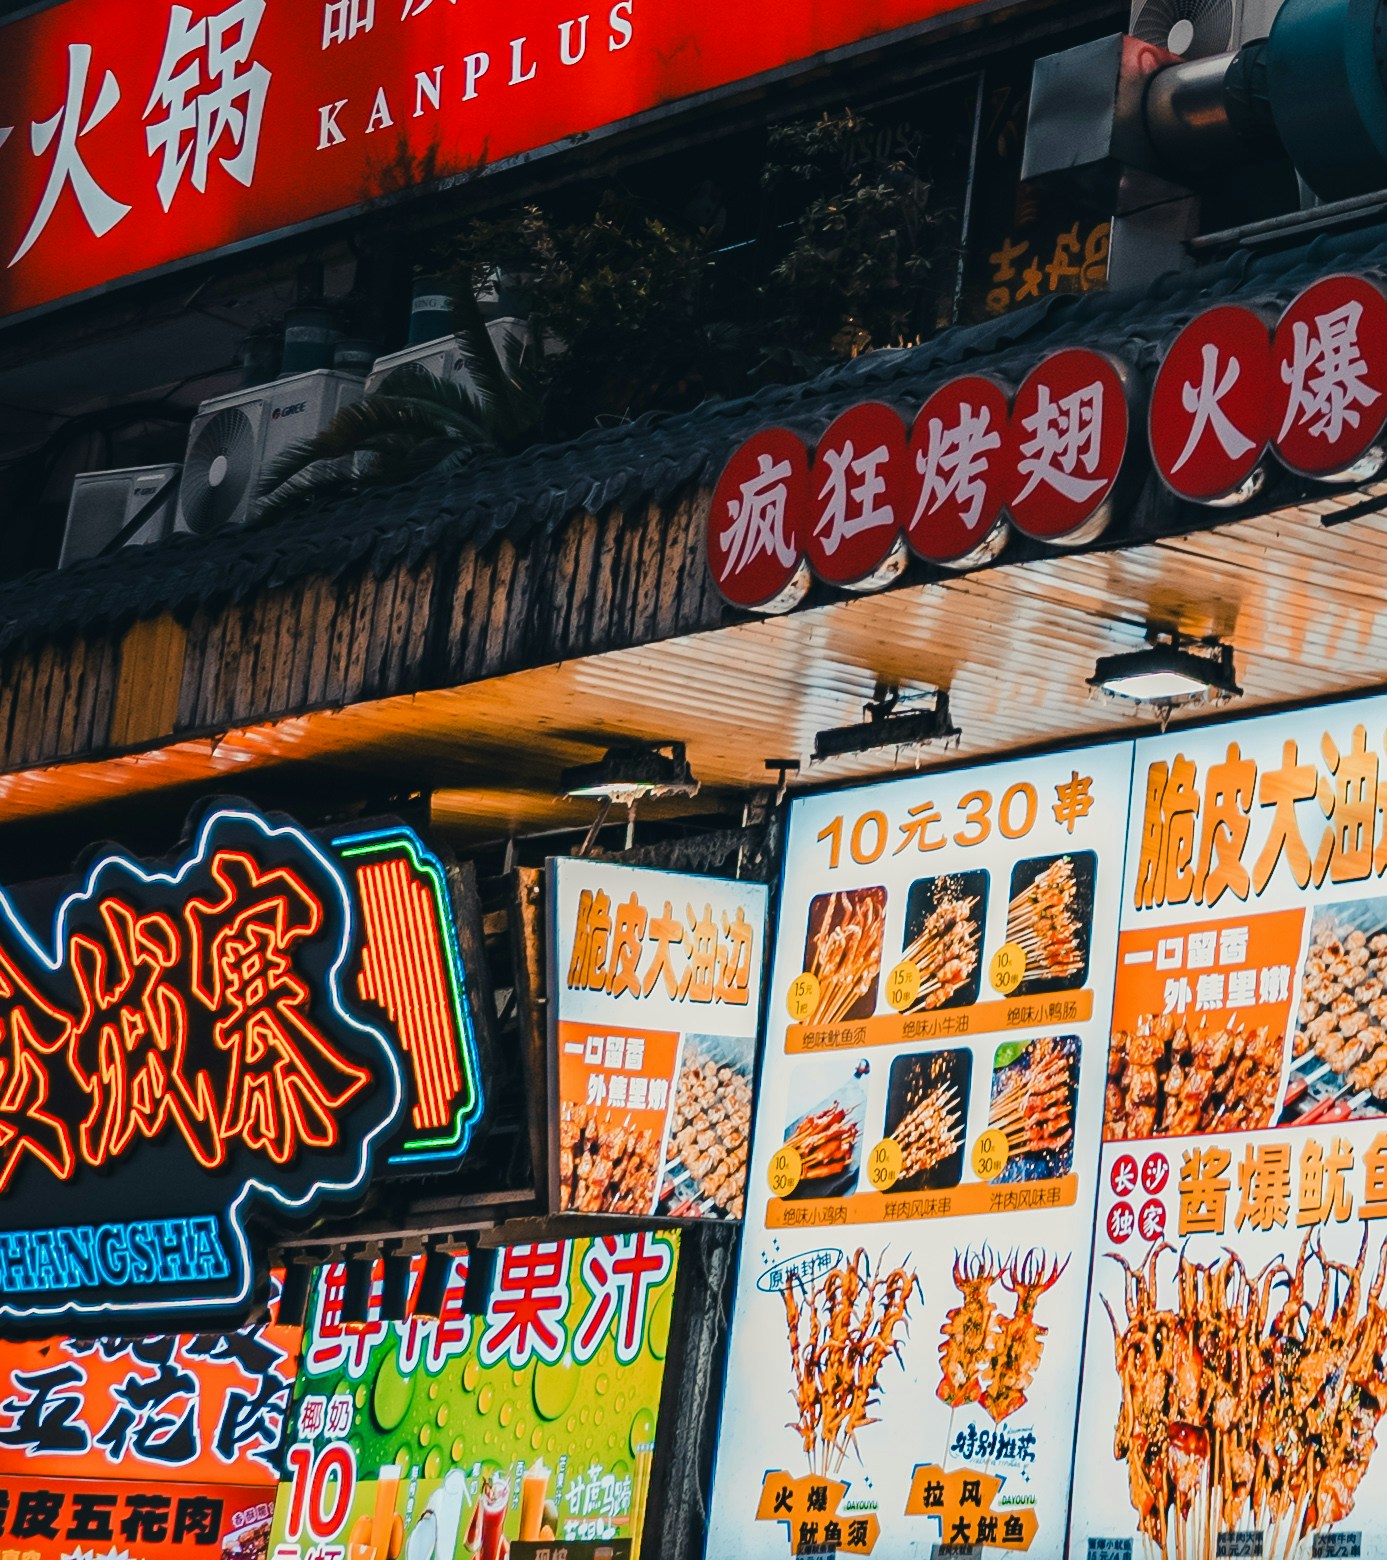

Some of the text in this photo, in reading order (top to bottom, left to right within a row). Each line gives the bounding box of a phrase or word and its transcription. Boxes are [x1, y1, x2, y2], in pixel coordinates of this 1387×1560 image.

[316, 0, 635, 150] KANPLUS
[720, 377, 1107, 584] 疯狂烤翅
[817, 771, 1095, 869] 10元30串
[566, 889, 753, 1008] 脆皮大油边
[1124, 927, 1248, 973] 一口留香
[286, 1443, 356, 1543] 10
[773, 1486, 828, 1513] 火爆
[923, 1481, 982, 1508] 拉风
[800, 1521, 868, 1547] 鱿鱼须
[951, 1517, 1024, 1544] 大鱿鱼
